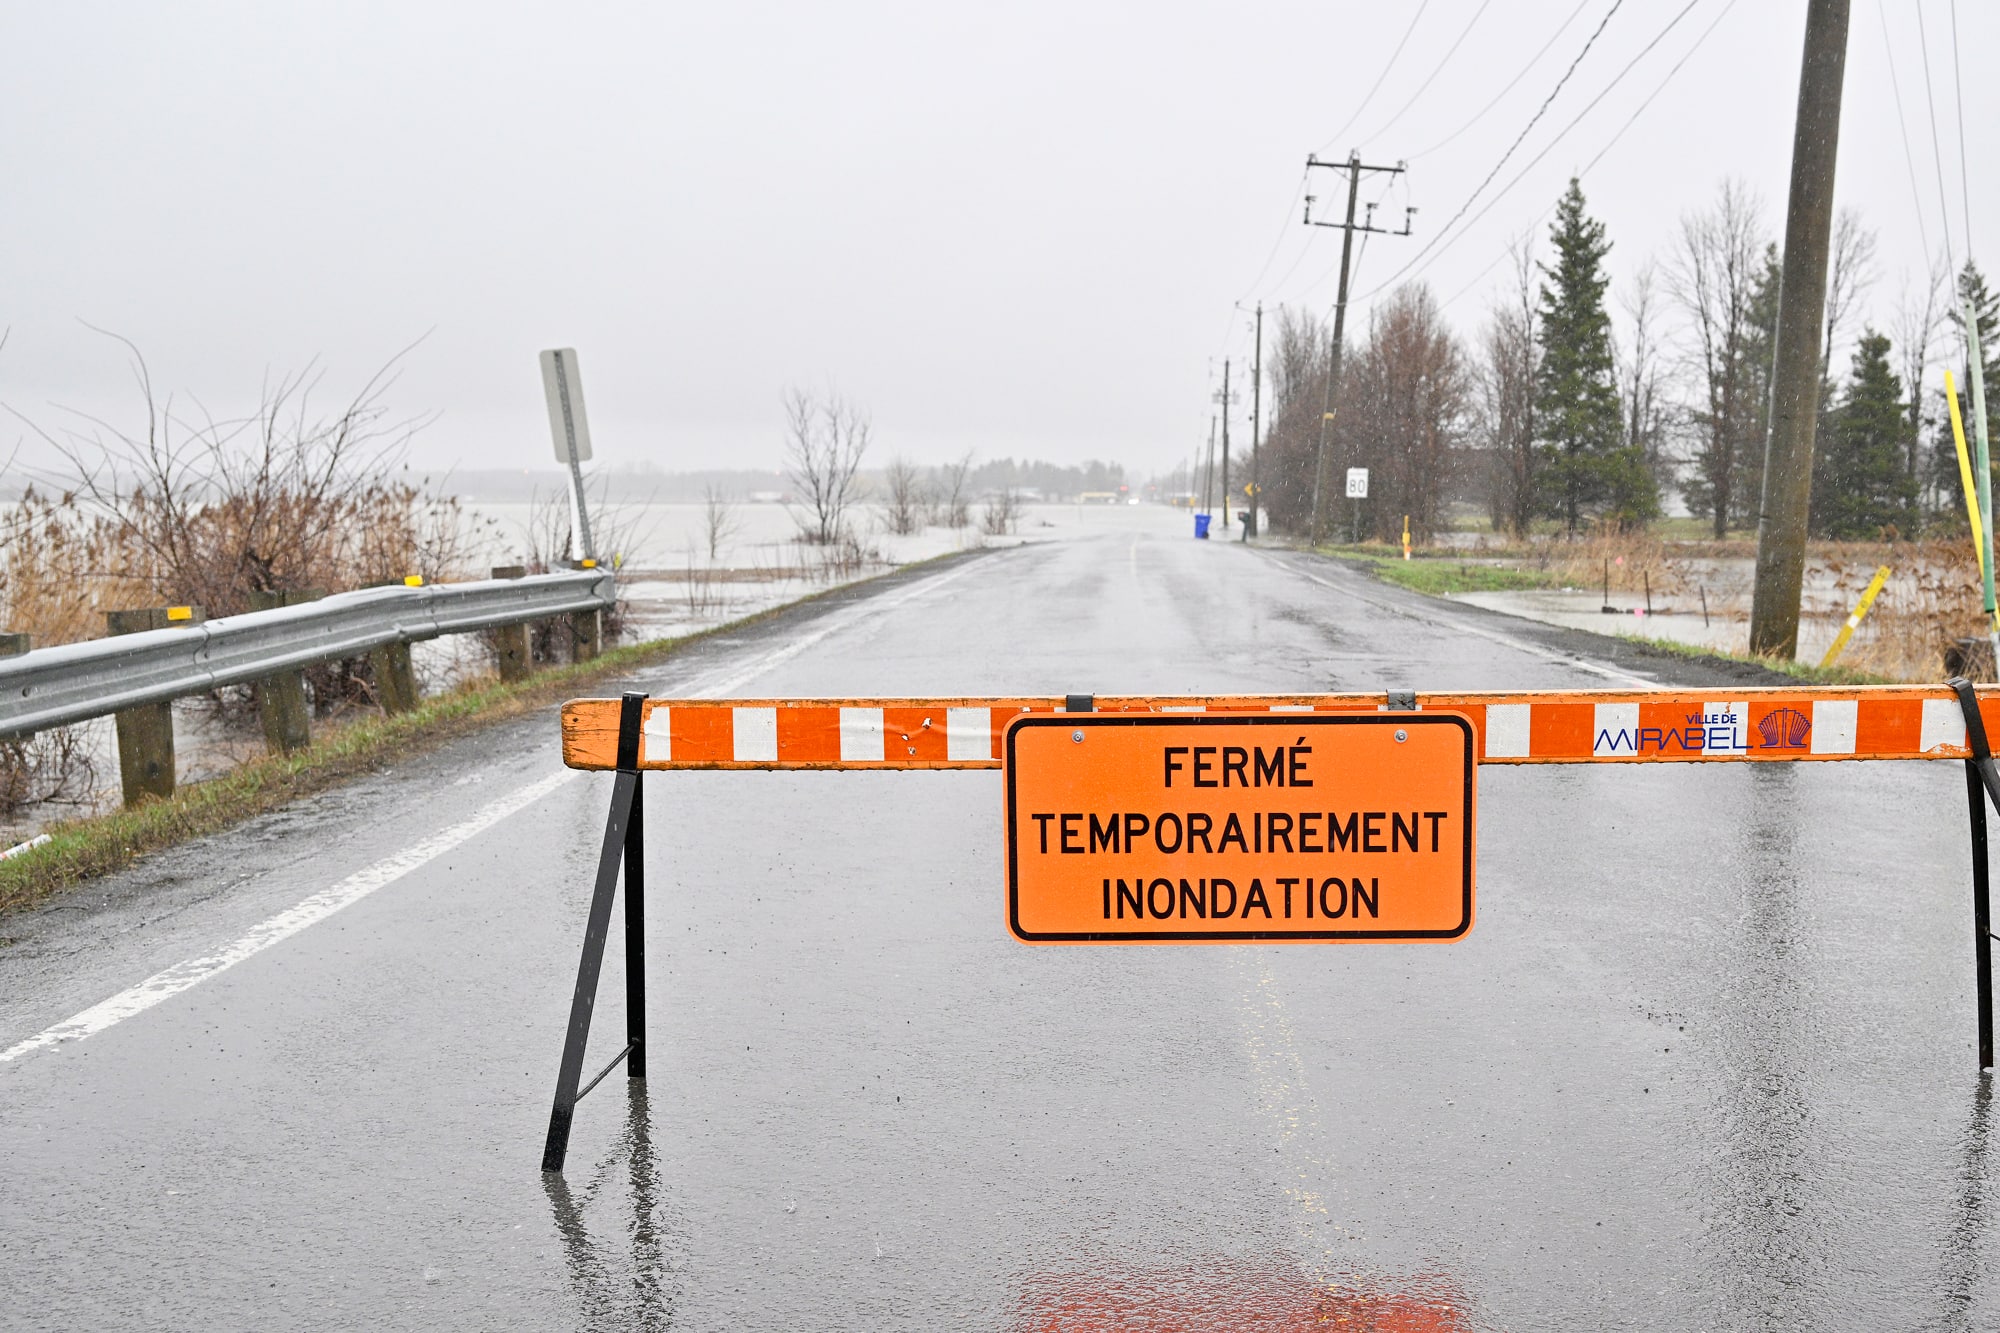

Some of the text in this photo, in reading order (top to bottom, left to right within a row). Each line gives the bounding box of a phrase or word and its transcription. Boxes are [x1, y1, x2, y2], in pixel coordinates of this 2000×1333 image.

[1349, 479, 1365, 493] 80
[1685, 712, 1737, 724] VILLE DE
[1594, 727, 1753, 750] MIRABEL
[1164, 736, 1314, 788] FERMÉ
[1031, 812, 1448, 854] TEMPORAIREMENT
[1102, 877, 1379, 919] INONDATION
